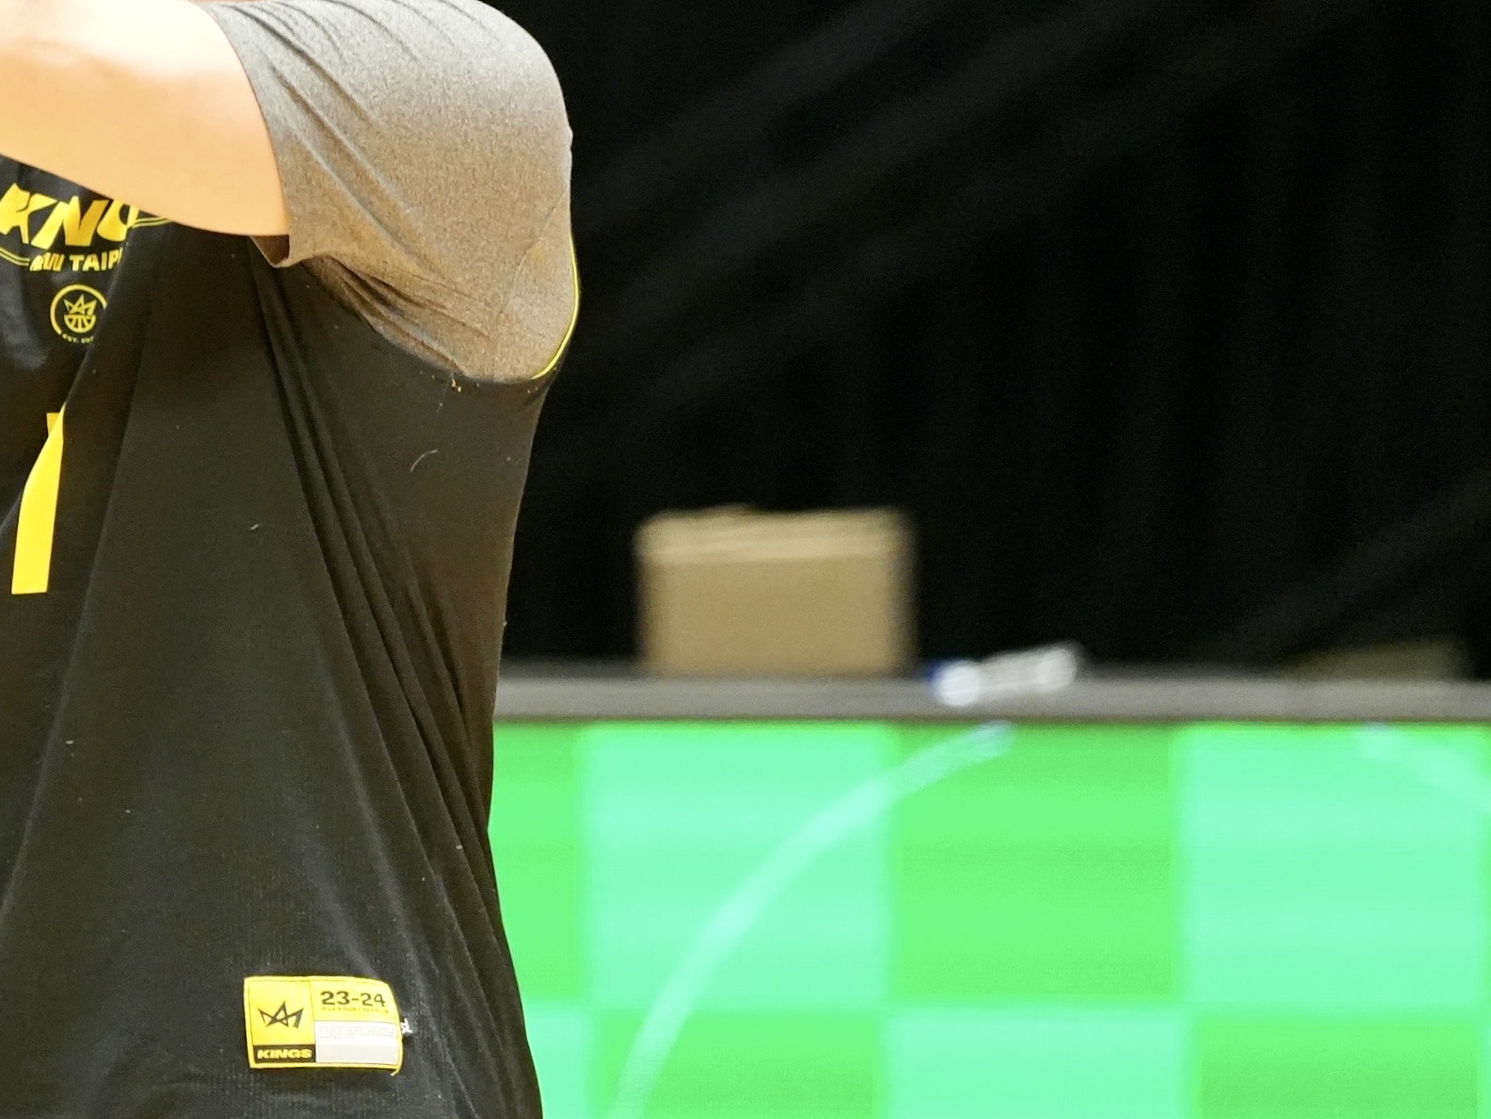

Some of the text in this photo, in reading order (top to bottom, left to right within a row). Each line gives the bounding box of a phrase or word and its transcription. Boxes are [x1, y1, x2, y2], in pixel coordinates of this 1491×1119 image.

[68, 246, 124, 272] TAIP
[320, 990, 387, 1008] 23-24
[256, 1048, 313, 1060] KINGS
